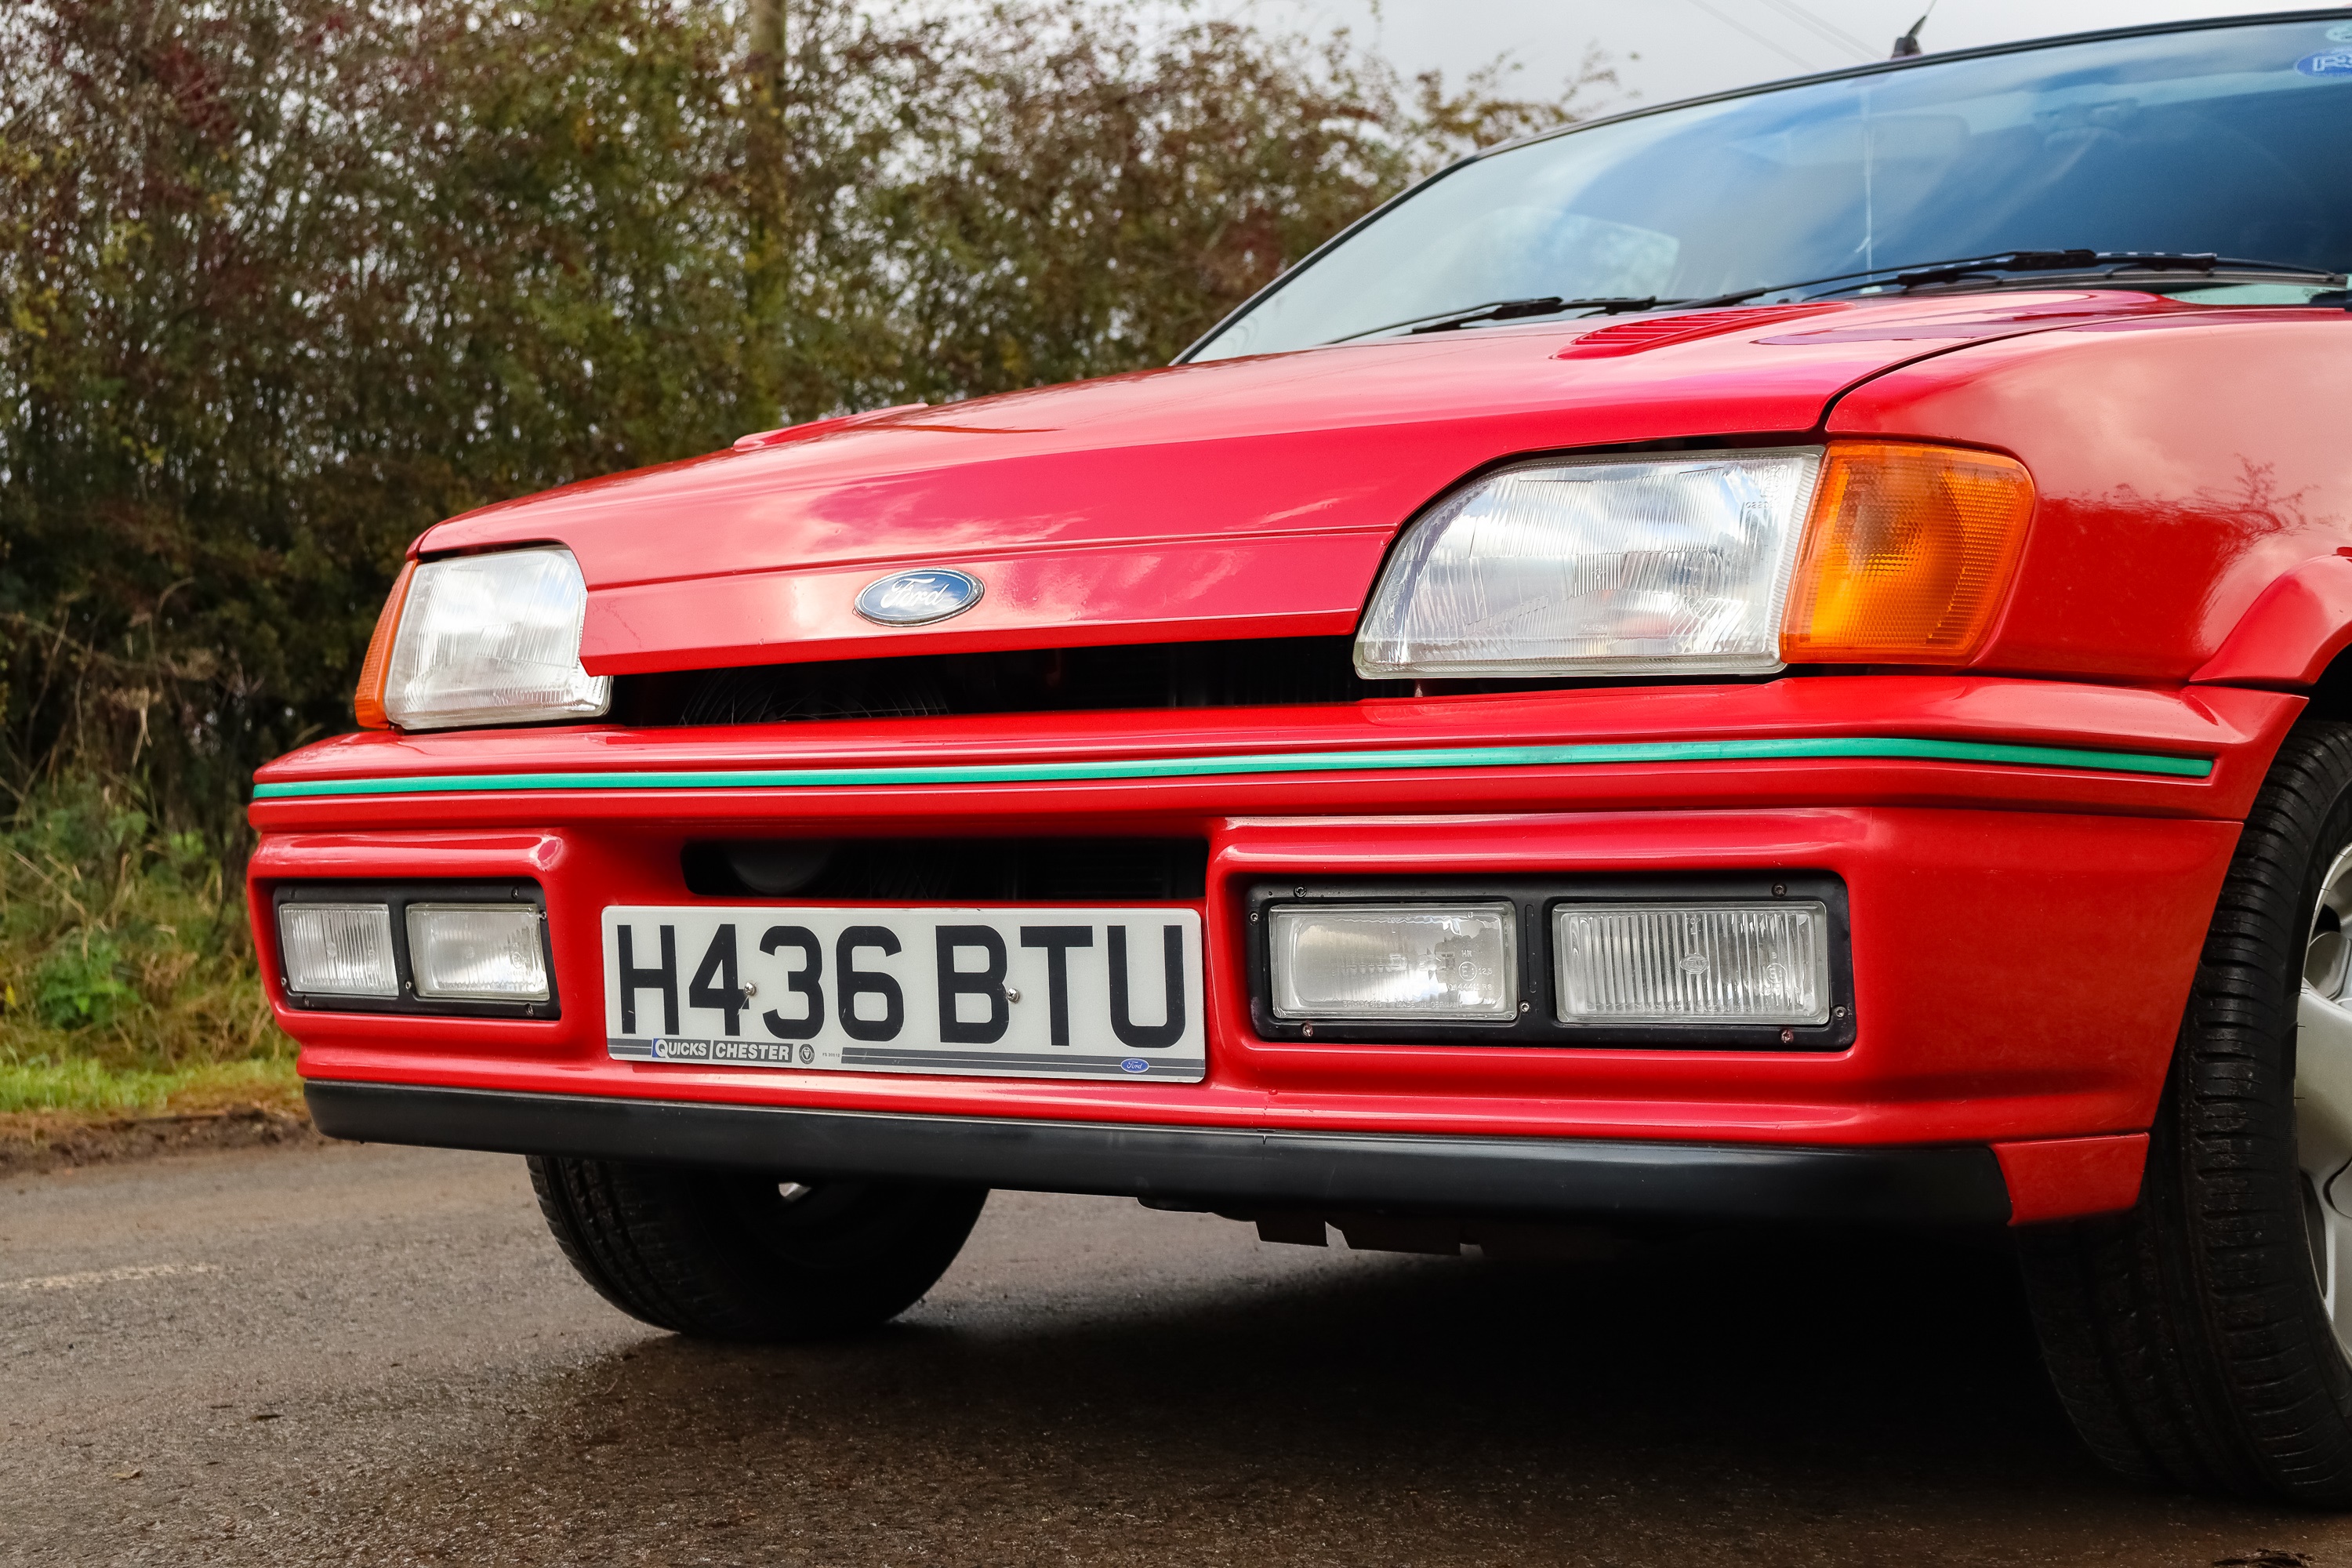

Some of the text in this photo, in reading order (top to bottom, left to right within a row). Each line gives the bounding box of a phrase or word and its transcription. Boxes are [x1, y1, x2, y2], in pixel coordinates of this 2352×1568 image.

[880, 577, 950, 608] Ford
[616, 924, 1186, 1047] H436 BTU
[655, 1039, 707, 1058] QUICKS
[715, 1042, 789, 1060] CHESTER
[1127, 1061, 1143, 1069] Ford
